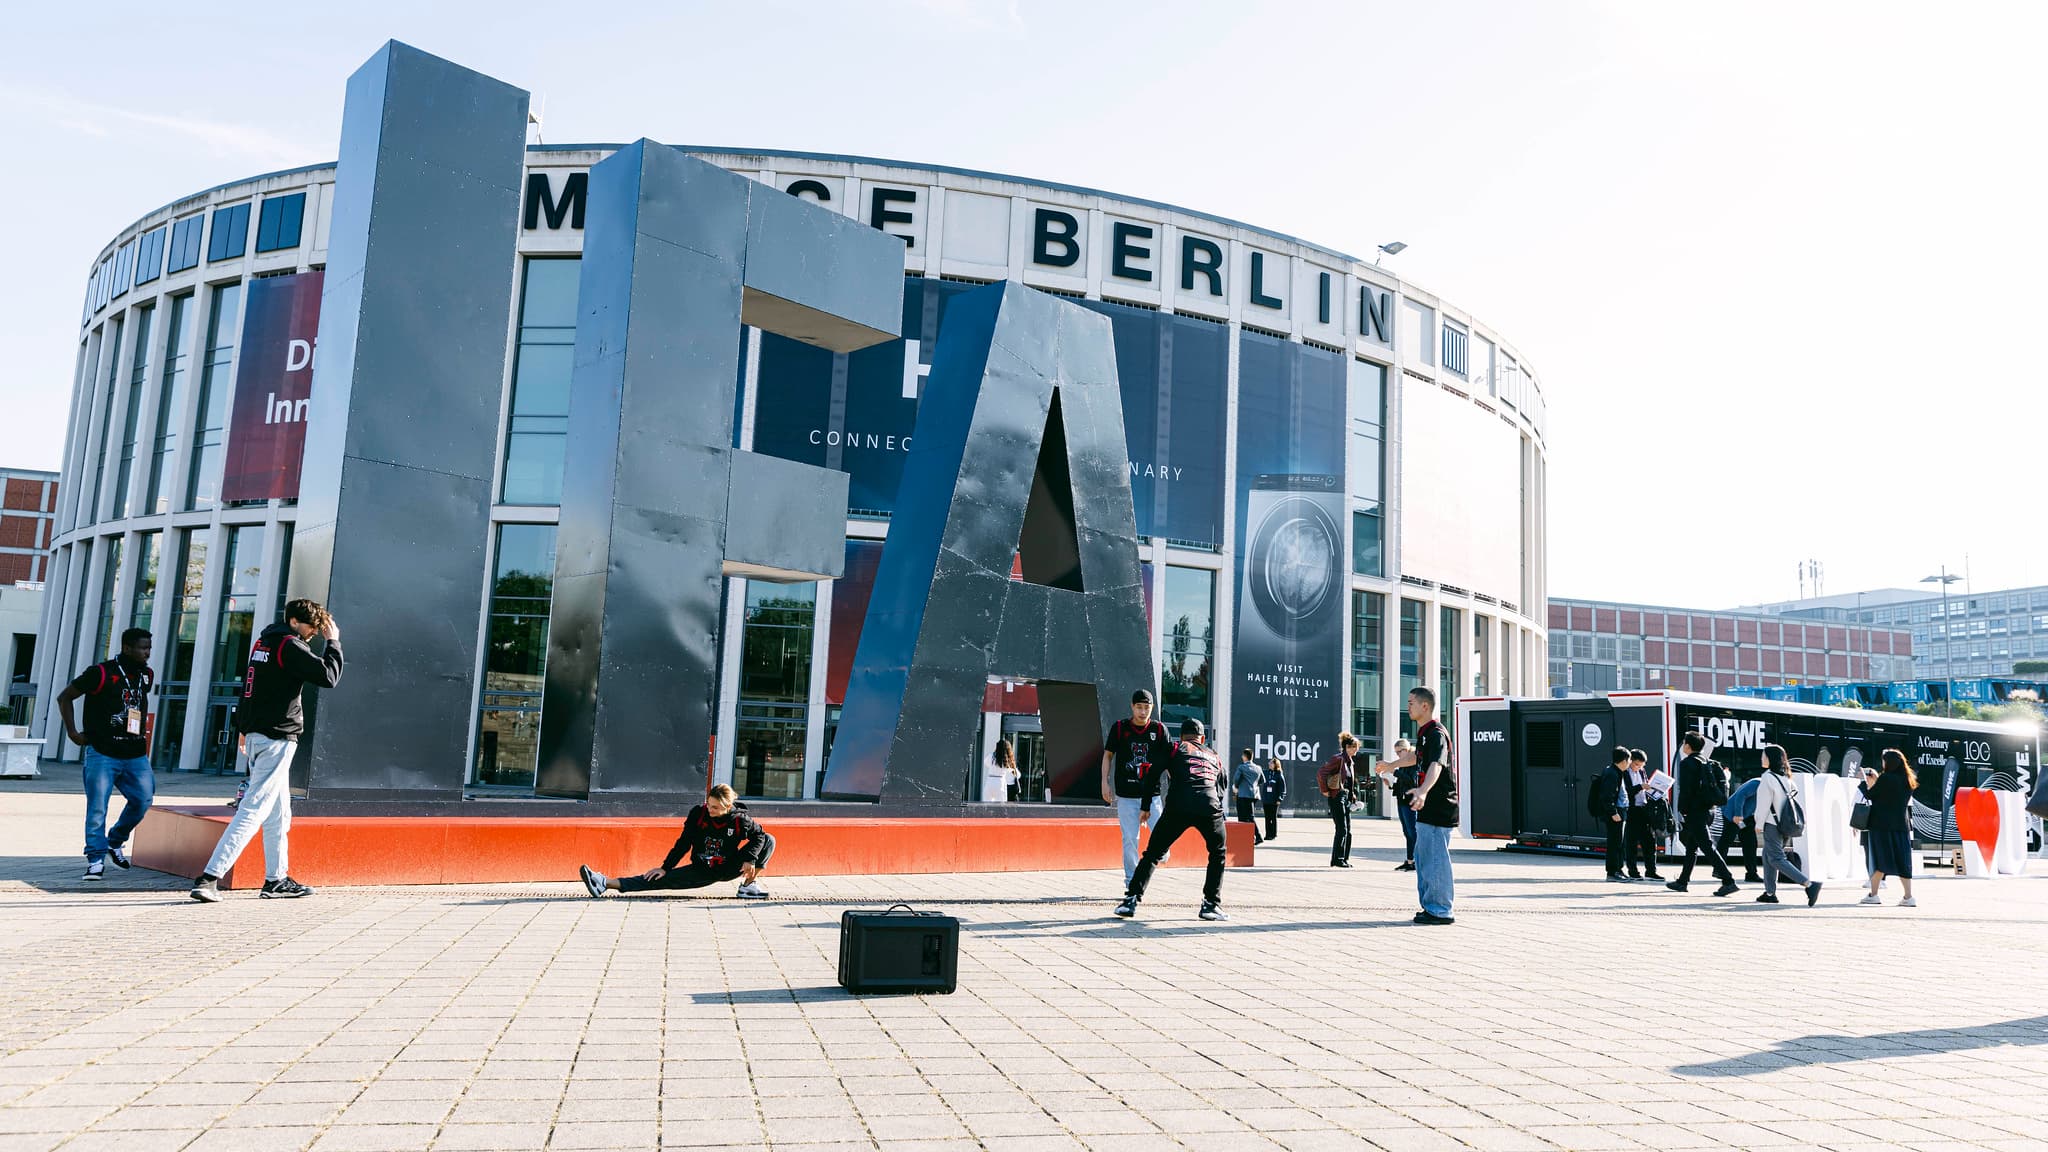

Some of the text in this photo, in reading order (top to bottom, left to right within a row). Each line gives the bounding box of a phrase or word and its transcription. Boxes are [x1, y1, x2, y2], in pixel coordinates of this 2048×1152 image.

[1033, 207, 1391, 343] BERLIN
[286, 337, 318, 371] Di
[265, 392, 311, 424] Inn
[291, 39, 1158, 803] IFA
[809, 429, 1182, 480] CONNEC NARY
[1247, 673, 1329, 688] HAIER PAVILLON
[1277, 664, 1303, 673] VISIT
[1258, 686, 1318, 698] AT HALL 3.1
[1254, 733, 1320, 762] Haier
[1917, 736, 1949, 752] A Century
[1963, 740, 1991, 761] 100
[1918, 753, 1926, 765] of
